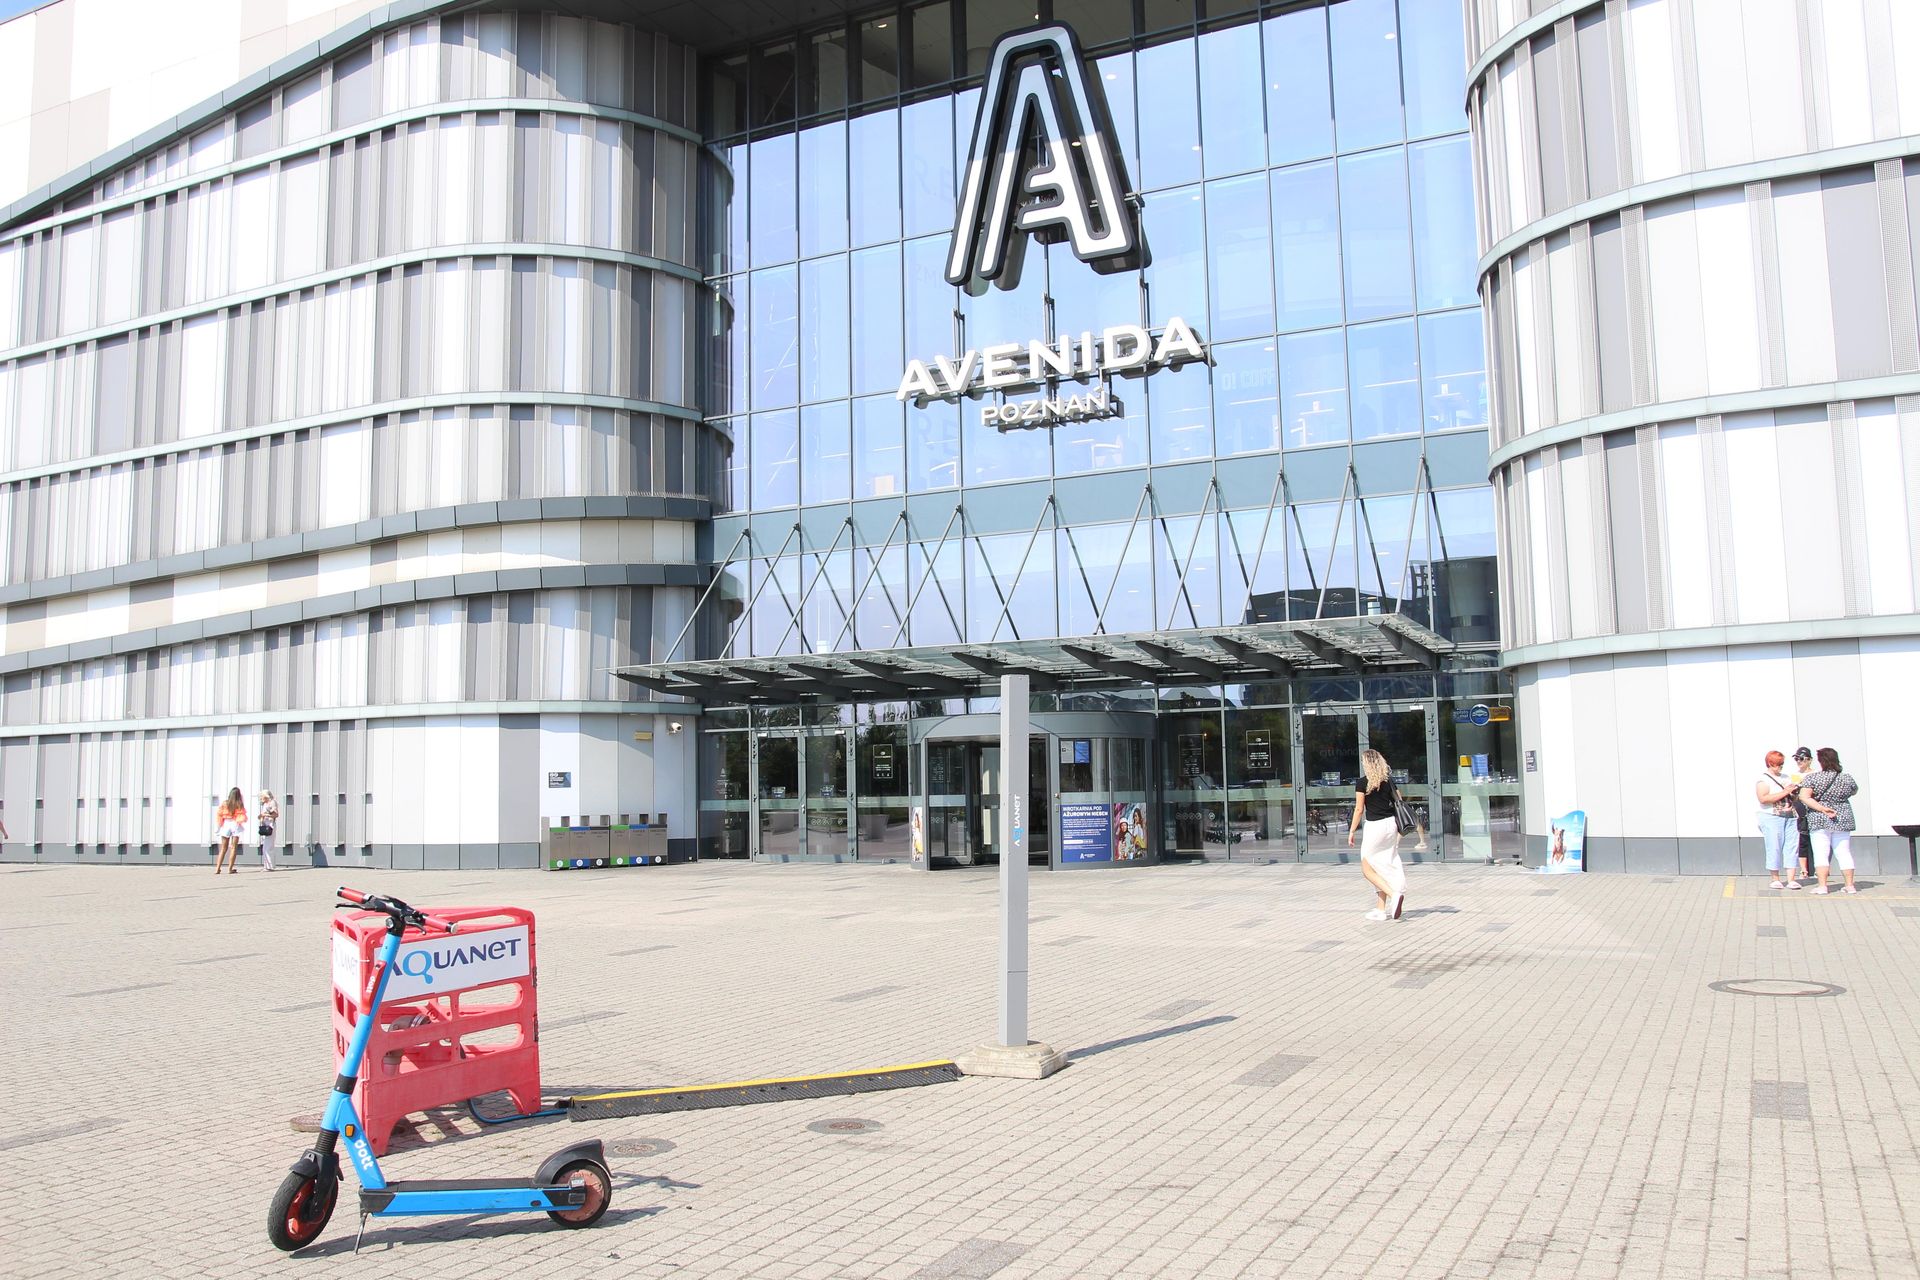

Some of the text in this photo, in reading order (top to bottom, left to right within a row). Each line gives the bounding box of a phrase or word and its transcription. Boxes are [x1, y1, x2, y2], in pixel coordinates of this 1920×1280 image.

[895, 316, 1204, 401] AVENIDA
[980, 385, 1111, 427] POZNAŃ
[365, 975, 376, 993] dott
[354, 1139, 374, 1171] dott
